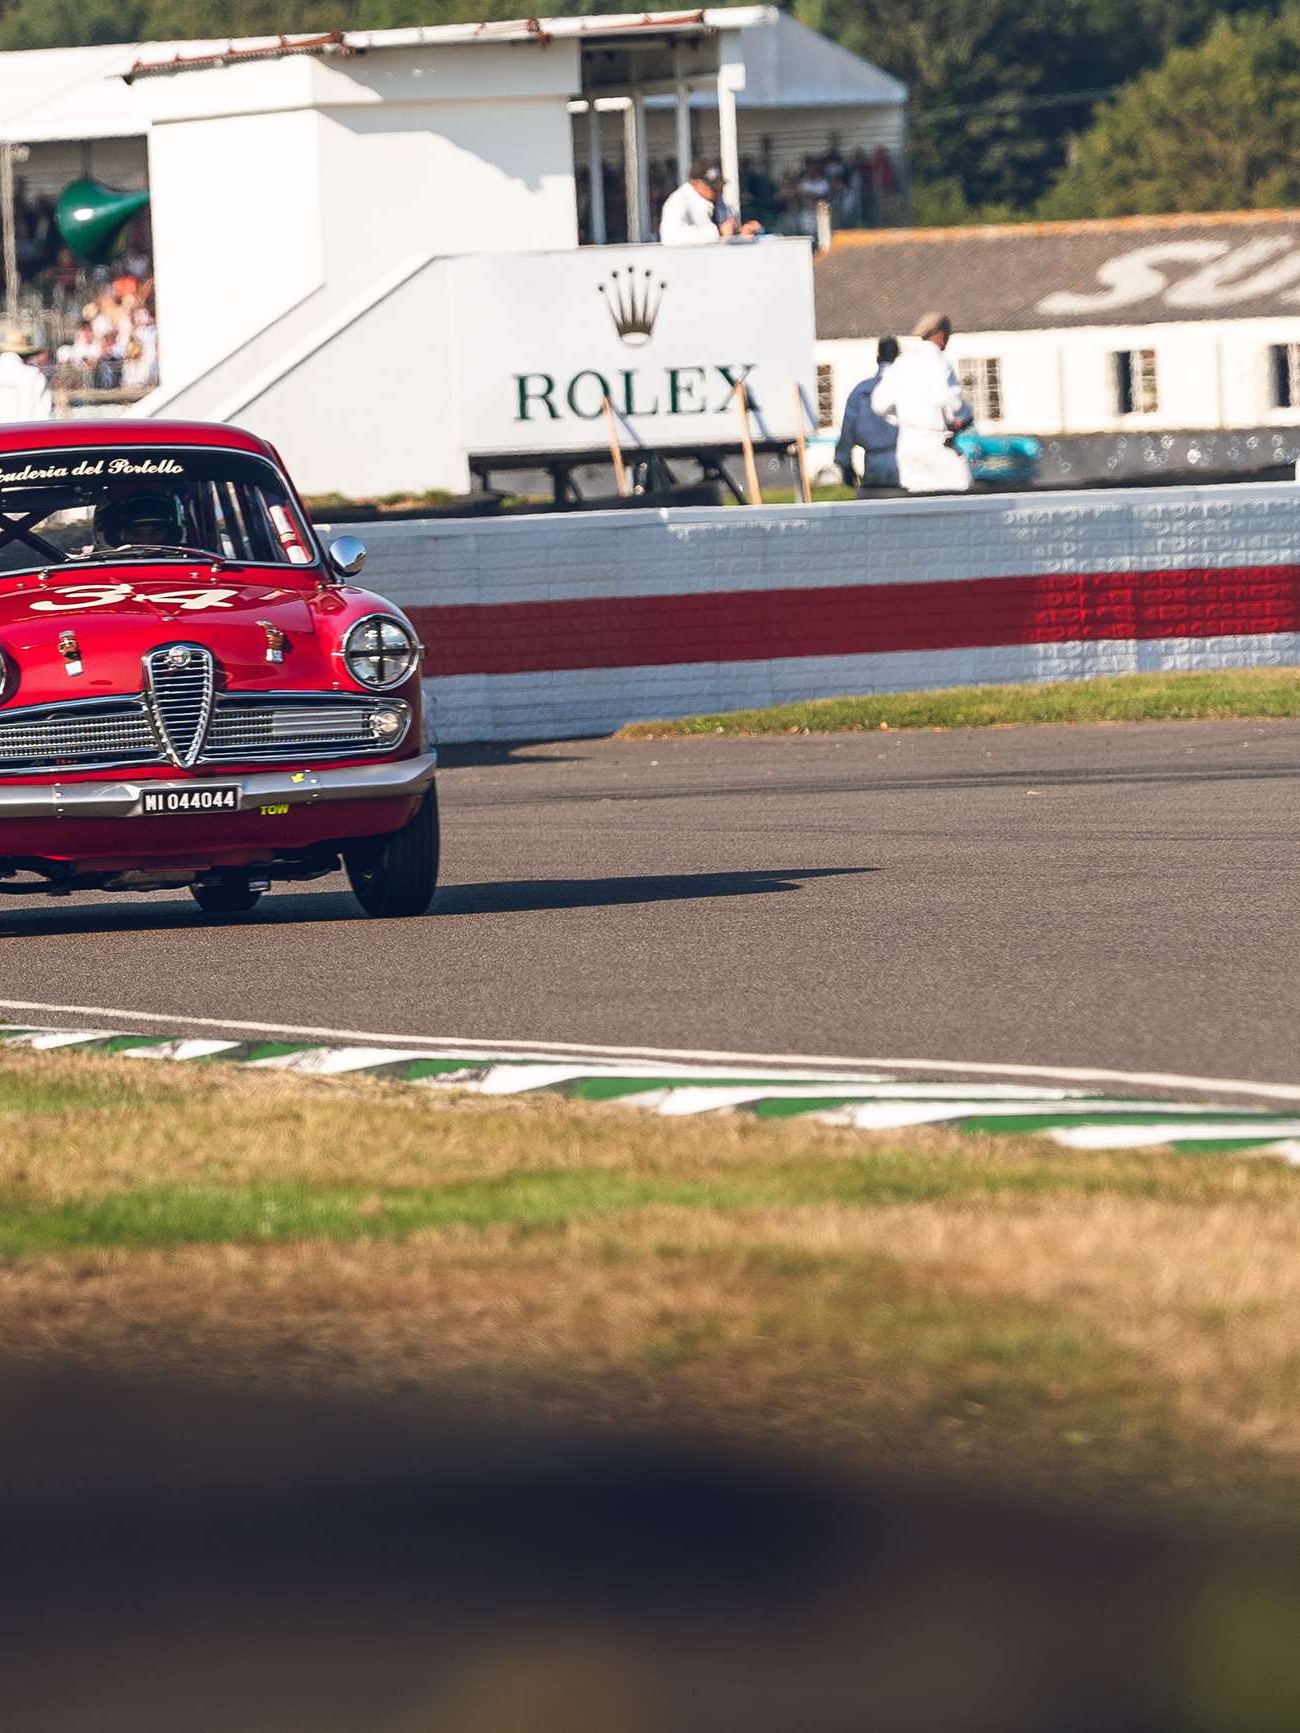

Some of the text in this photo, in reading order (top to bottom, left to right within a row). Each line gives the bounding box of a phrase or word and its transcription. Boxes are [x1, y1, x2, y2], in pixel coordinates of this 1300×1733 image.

[1034, 234, 1300, 317] SU
[512, 362, 761, 421] ROLEX
[71, 460, 104, 477] del
[107, 458, 184, 475] Portello
[29, 583, 239, 611] 34
[167, 790, 235, 810] 044044
[260, 803, 290, 816] TOW
